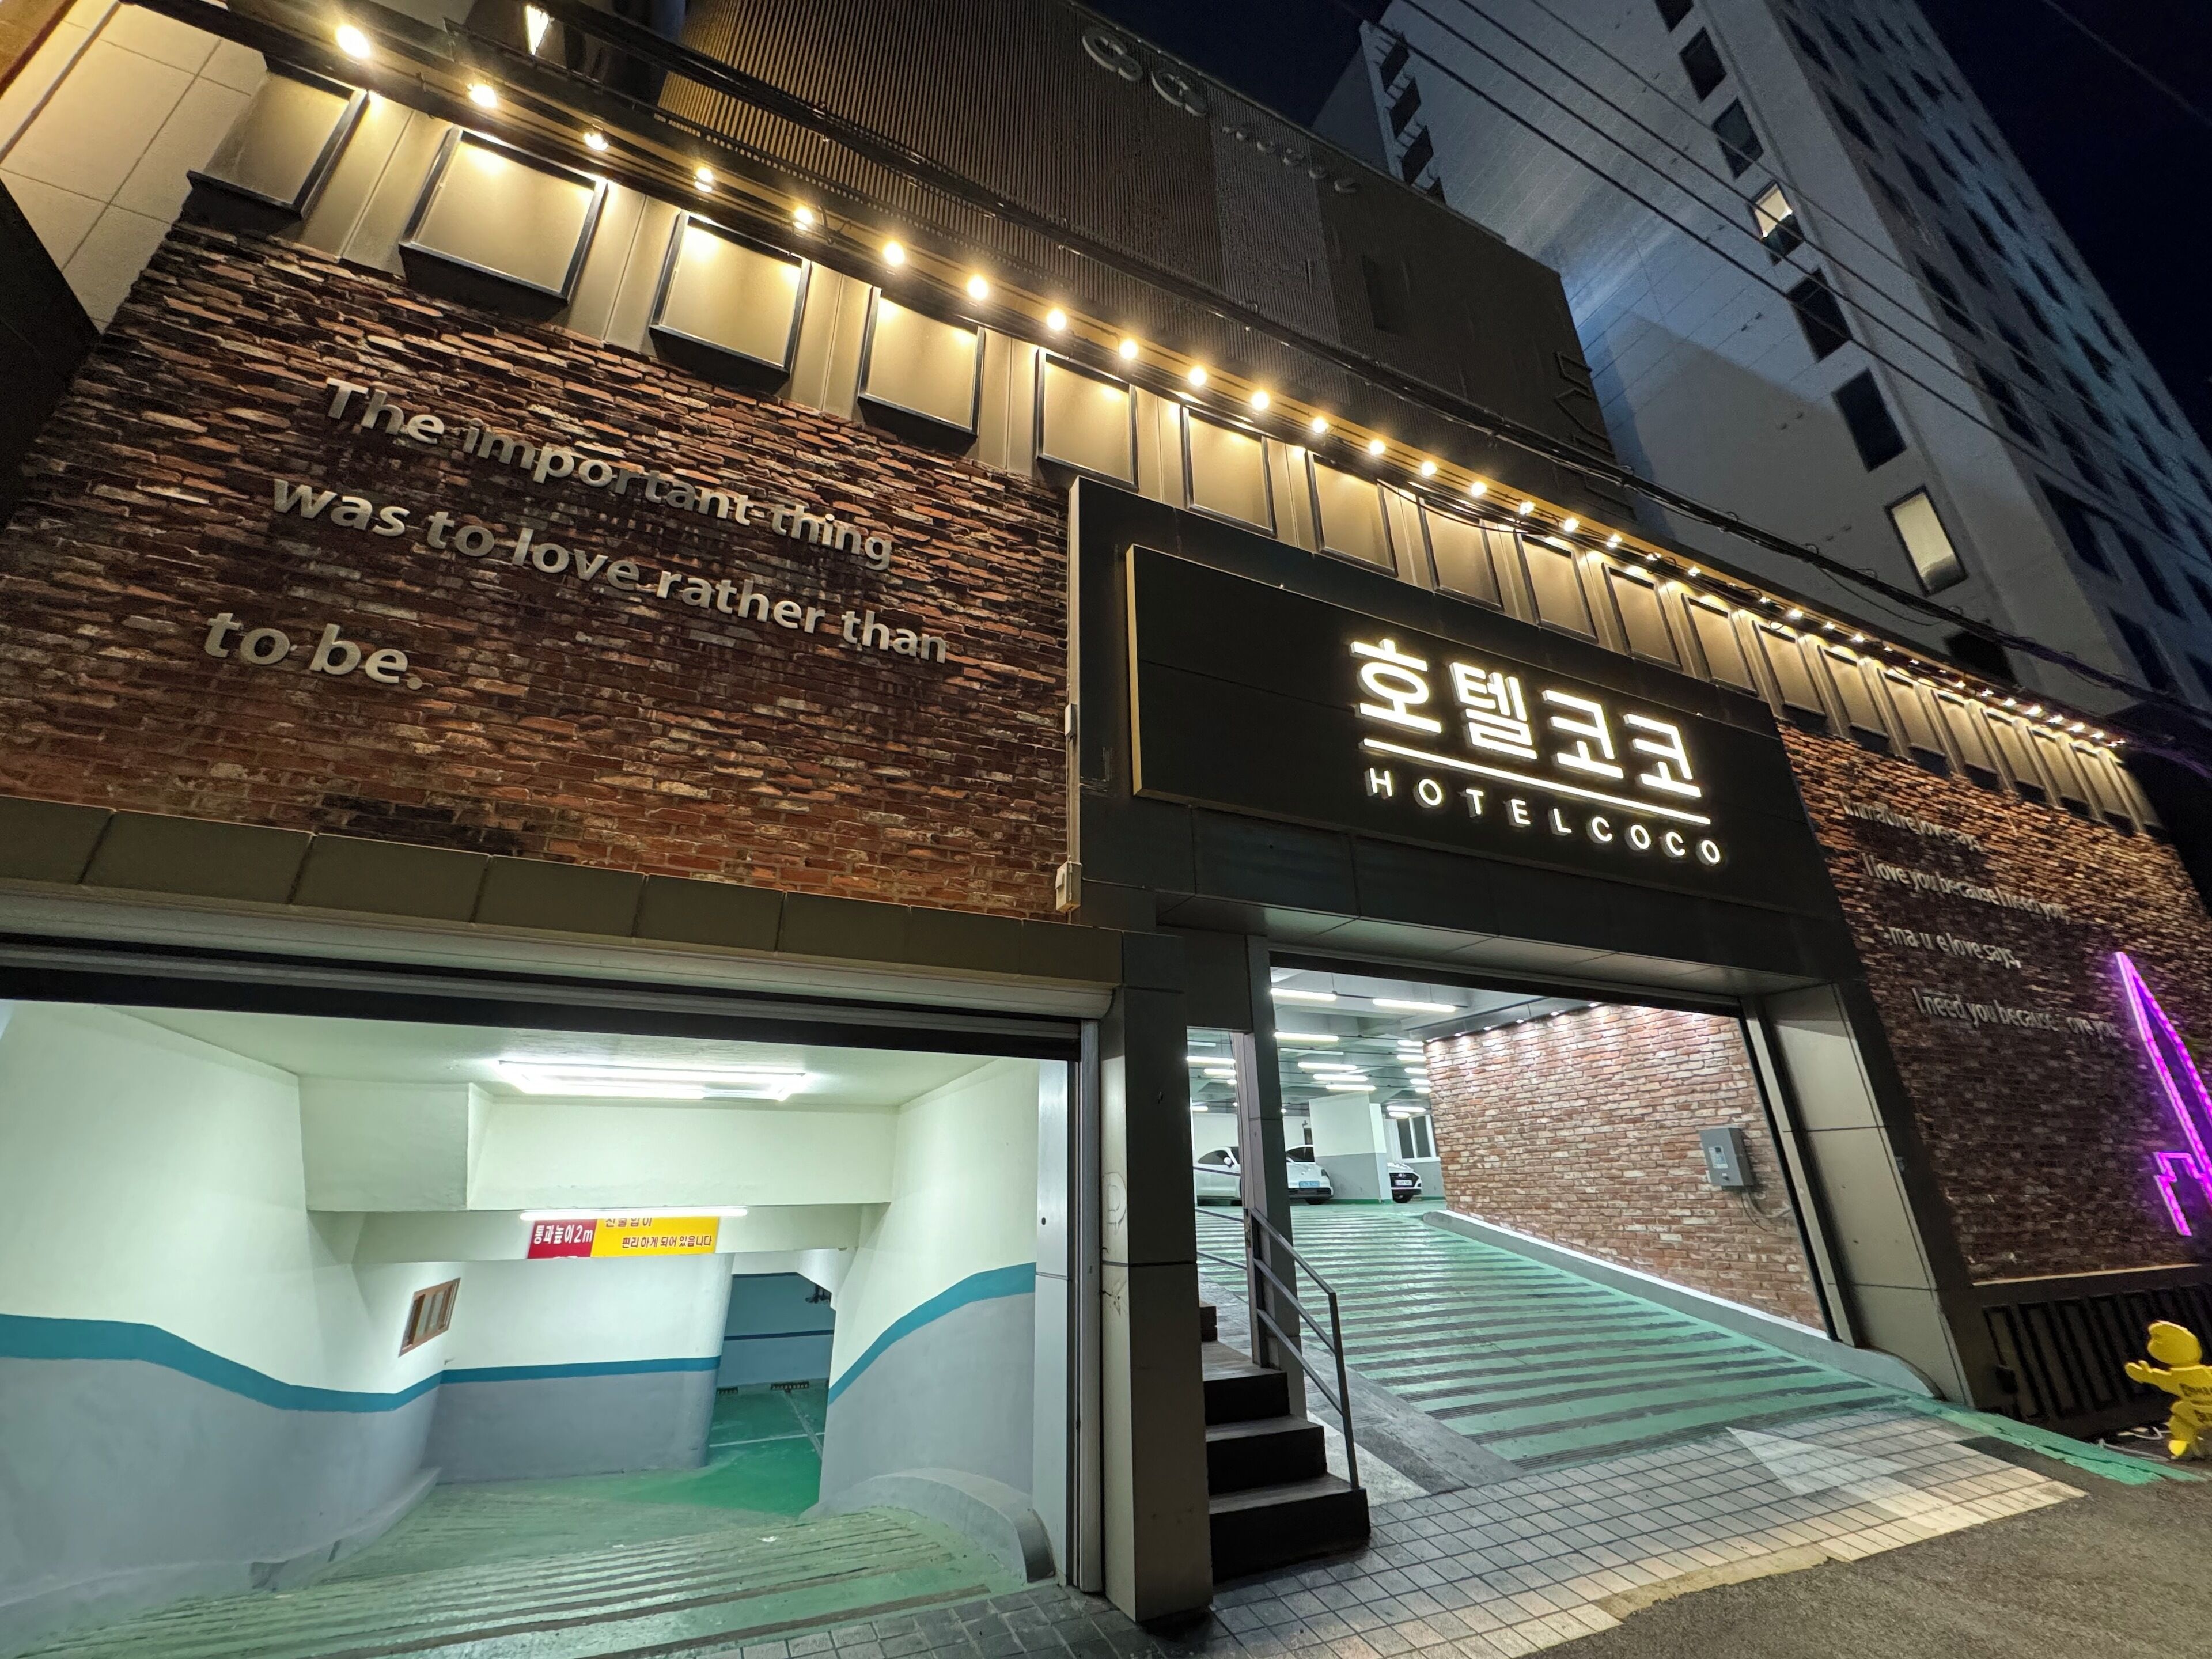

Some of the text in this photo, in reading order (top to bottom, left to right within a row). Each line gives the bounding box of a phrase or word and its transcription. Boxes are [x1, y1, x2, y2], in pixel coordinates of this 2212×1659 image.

[326, 377, 891, 570] The important thing
[274, 479, 946, 664] was to love rather than
[204, 612, 423, 691] to be.
[1350, 638, 1702, 798] 호텔코코
[1869, 855, 1911, 885] love
[1907, 869, 1940, 893] you
[1934, 870, 2000, 906] because
[1945, 932, 1984, 959] love
[1922, 994, 1969, 1020] need
[1965, 1003, 1999, 1028] you
[1993, 999, 2059, 1032] because
[622, 1236, 658, 1248] 편리하게
